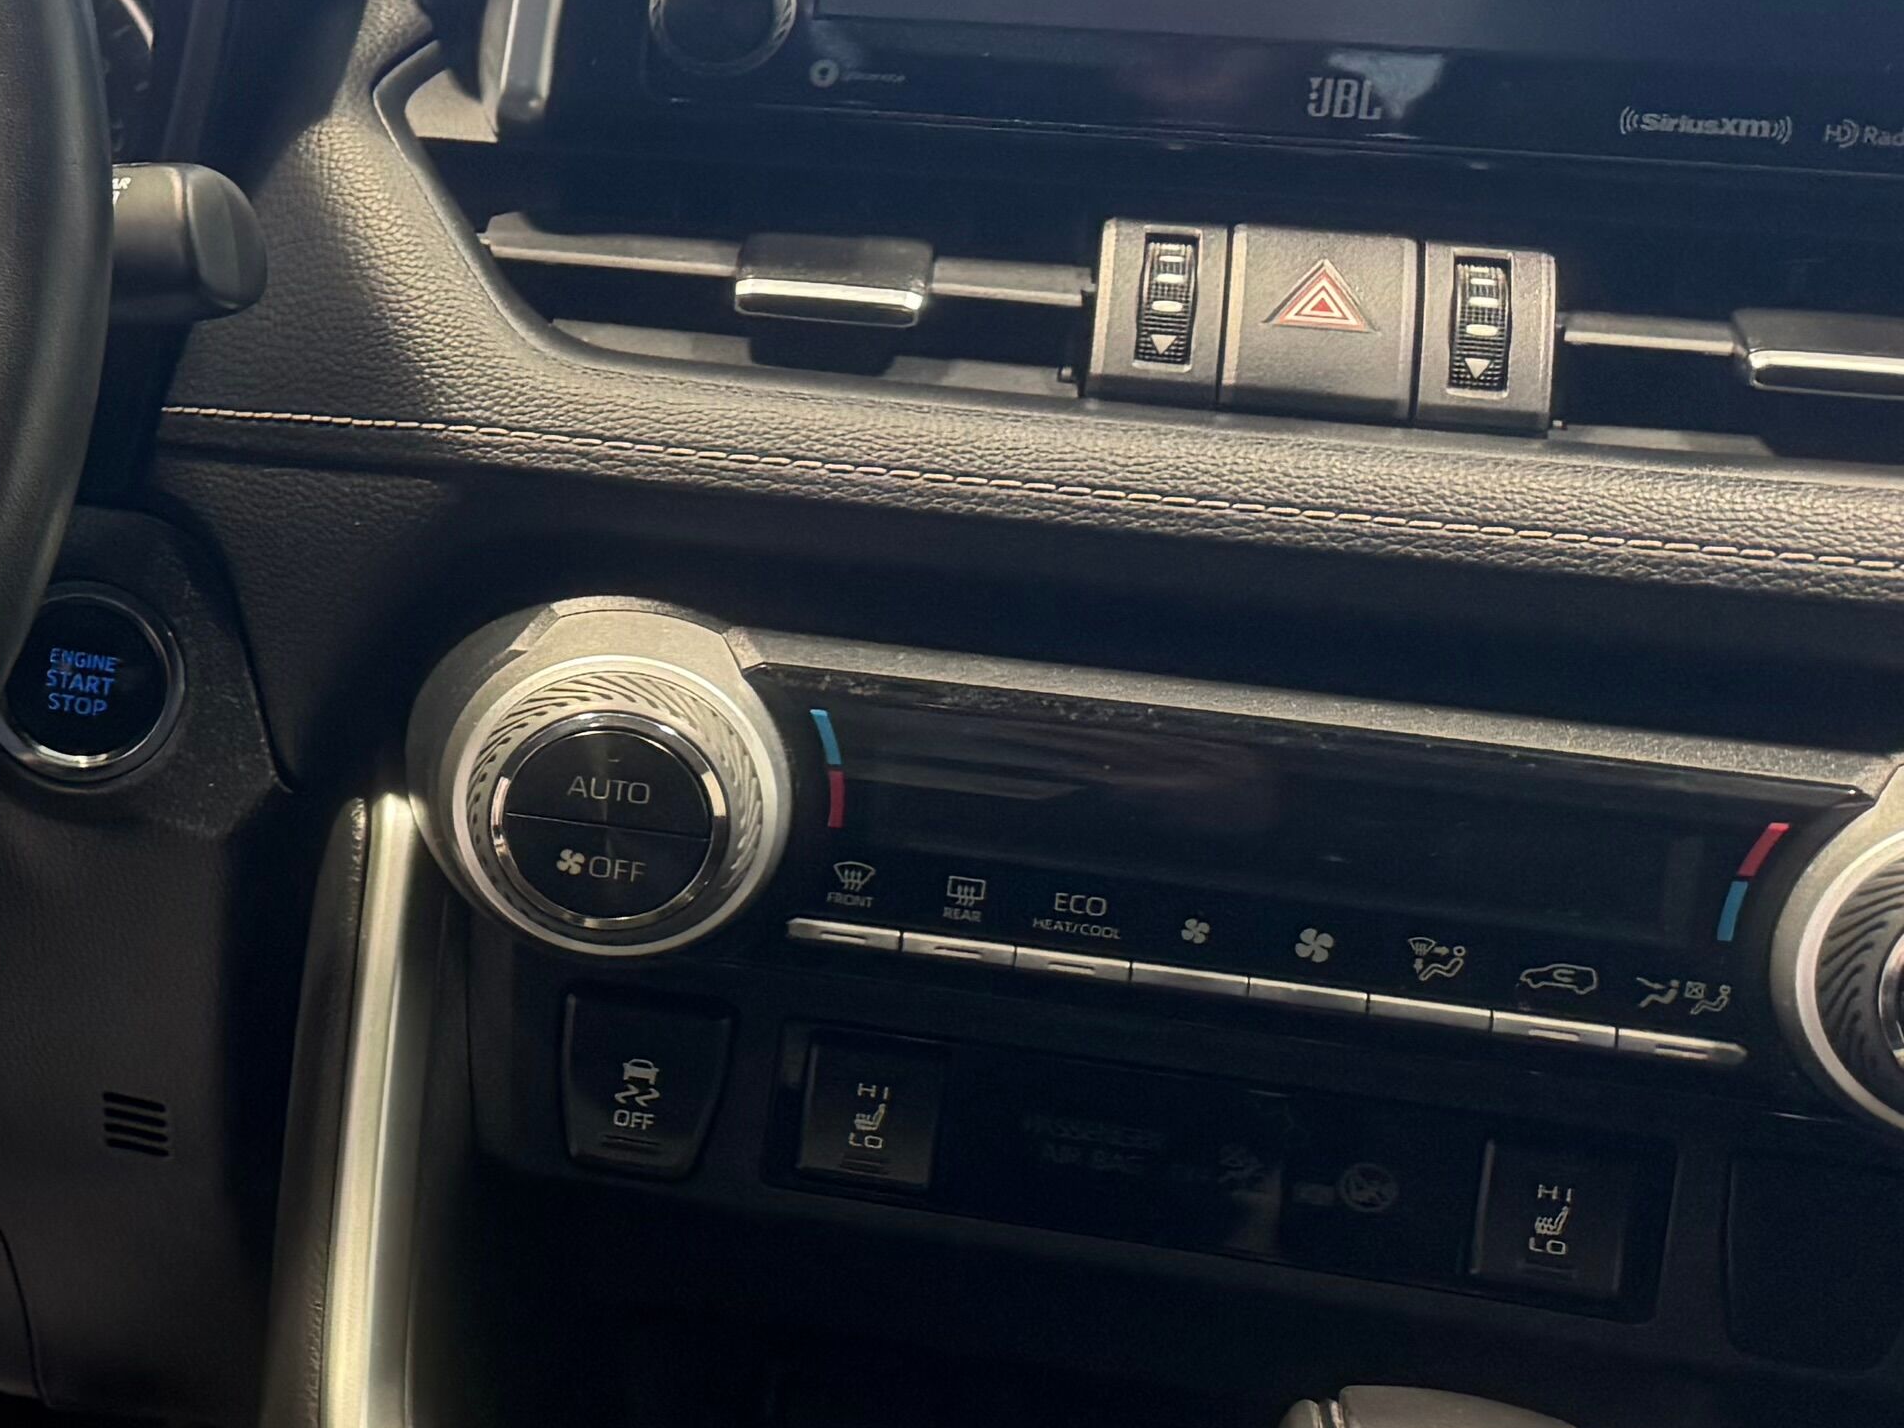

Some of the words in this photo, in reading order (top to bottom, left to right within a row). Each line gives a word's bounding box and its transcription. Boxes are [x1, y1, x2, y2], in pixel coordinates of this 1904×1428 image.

[1308, 77, 1382, 121] JBL
[49, 648, 117, 674] ENGINE
[45, 669, 115, 697] START
[48, 692, 108, 719] STOP
[566, 774, 651, 806] AUTO
[587, 855, 648, 884] OFF
[826, 891, 875, 910] FRONT
[1053, 892, 1108, 918] ECO
[943, 906, 983, 923] REAR
[1032, 917, 1122, 941] HEAT/COOL
[856, 1082, 891, 1100] HI
[613, 1110, 655, 1131] OFF
[1537, 1183, 1573, 1203] HI
